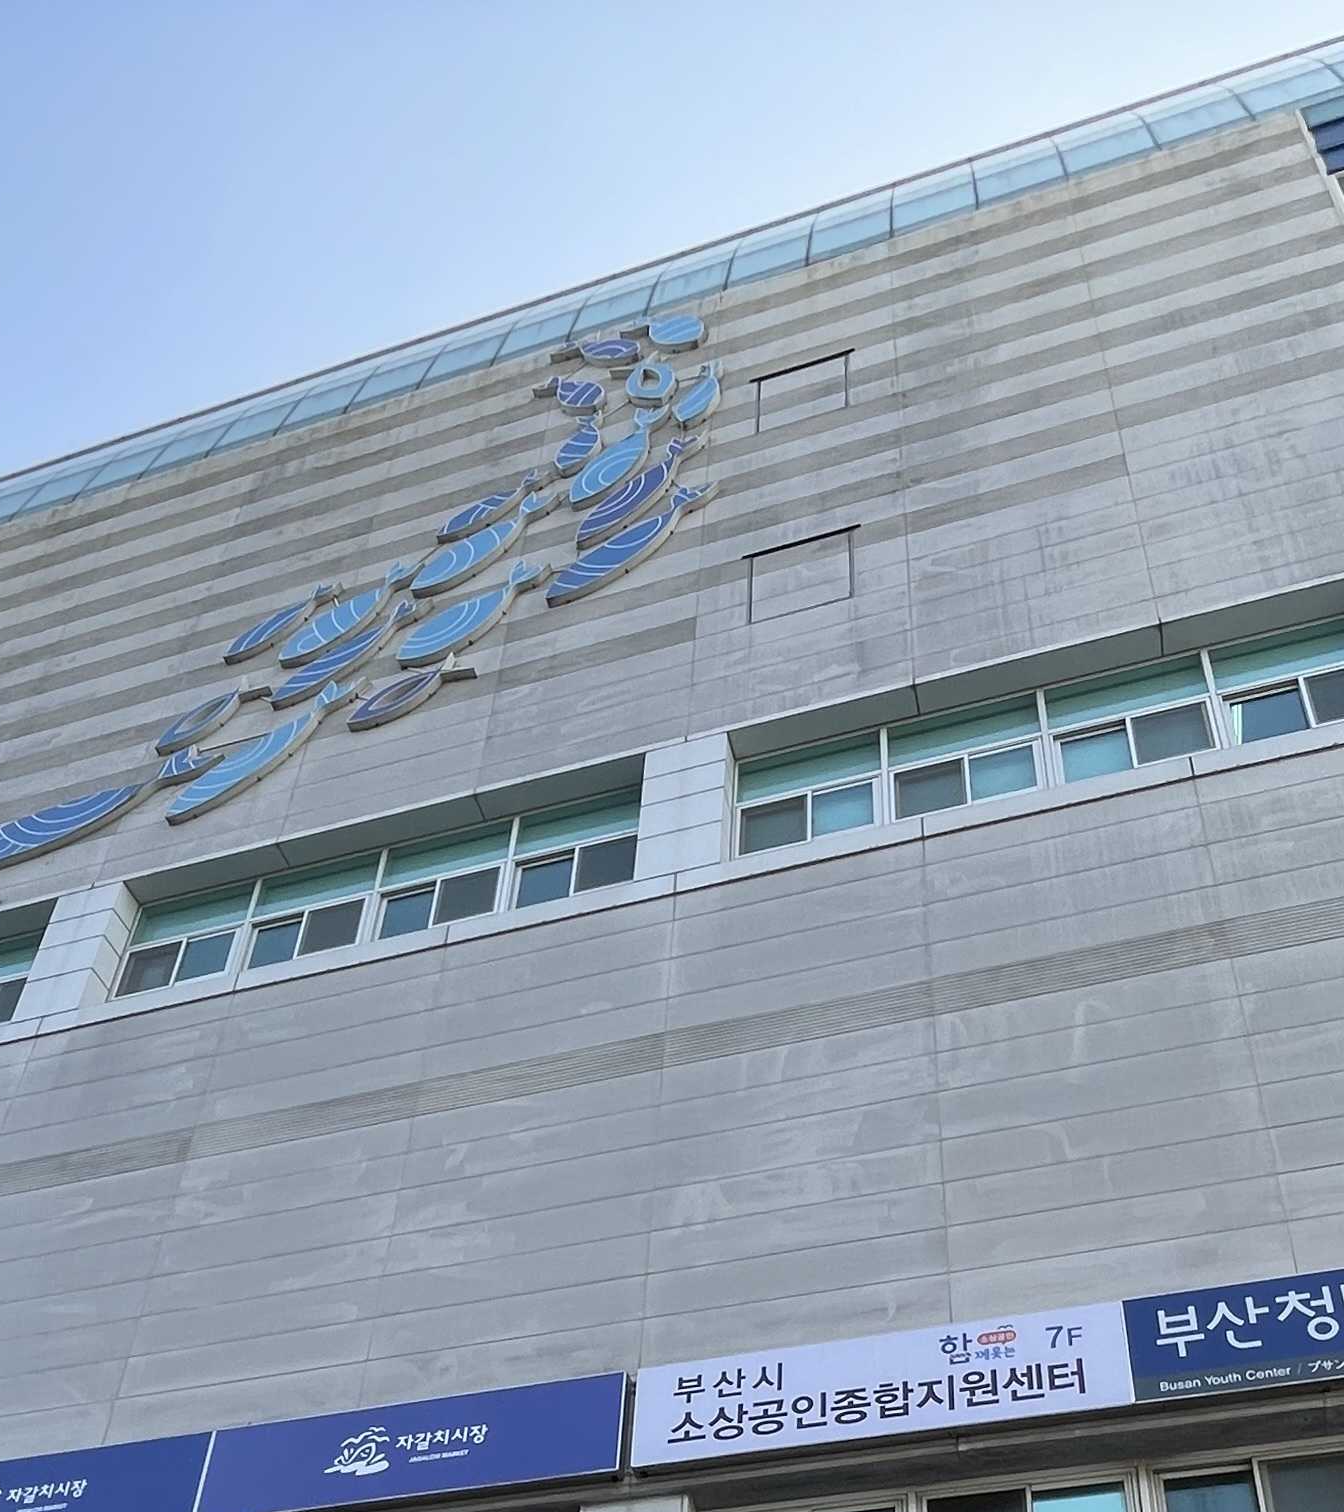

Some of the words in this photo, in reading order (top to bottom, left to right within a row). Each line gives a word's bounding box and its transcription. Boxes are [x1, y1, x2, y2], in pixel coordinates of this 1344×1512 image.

[1045, 1326, 1083, 1349] 7F
[673, 1361, 784, 1404] 부산시
[1159, 1378, 1201, 1392] Busan
[1204, 1371, 1242, 1387] Youth
[1245, 1365, 1292, 1381] Center
[666, 1358, 1087, 1446] 소상공인종합지원센터
[395, 1424, 489, 1451] 자갈치시장
[6, 1479, 88, 1504] 자갈치시장
